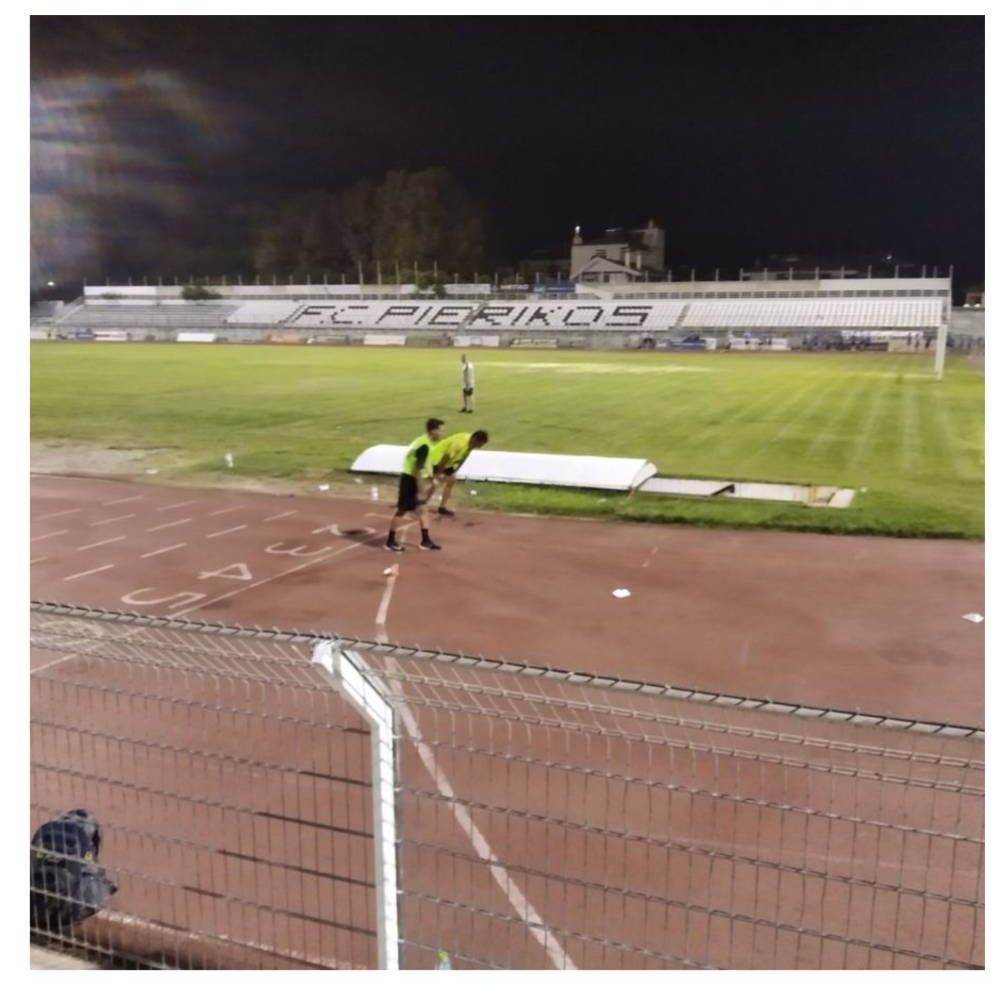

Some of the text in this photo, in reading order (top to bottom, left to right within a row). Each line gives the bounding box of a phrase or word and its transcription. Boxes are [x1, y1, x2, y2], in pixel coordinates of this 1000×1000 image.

[292, 304, 653, 328] F.C. PIERIKOS
[263, 541, 332, 557] 3
[197, 562, 253, 581] 4
[120, 586, 207, 610] 5
